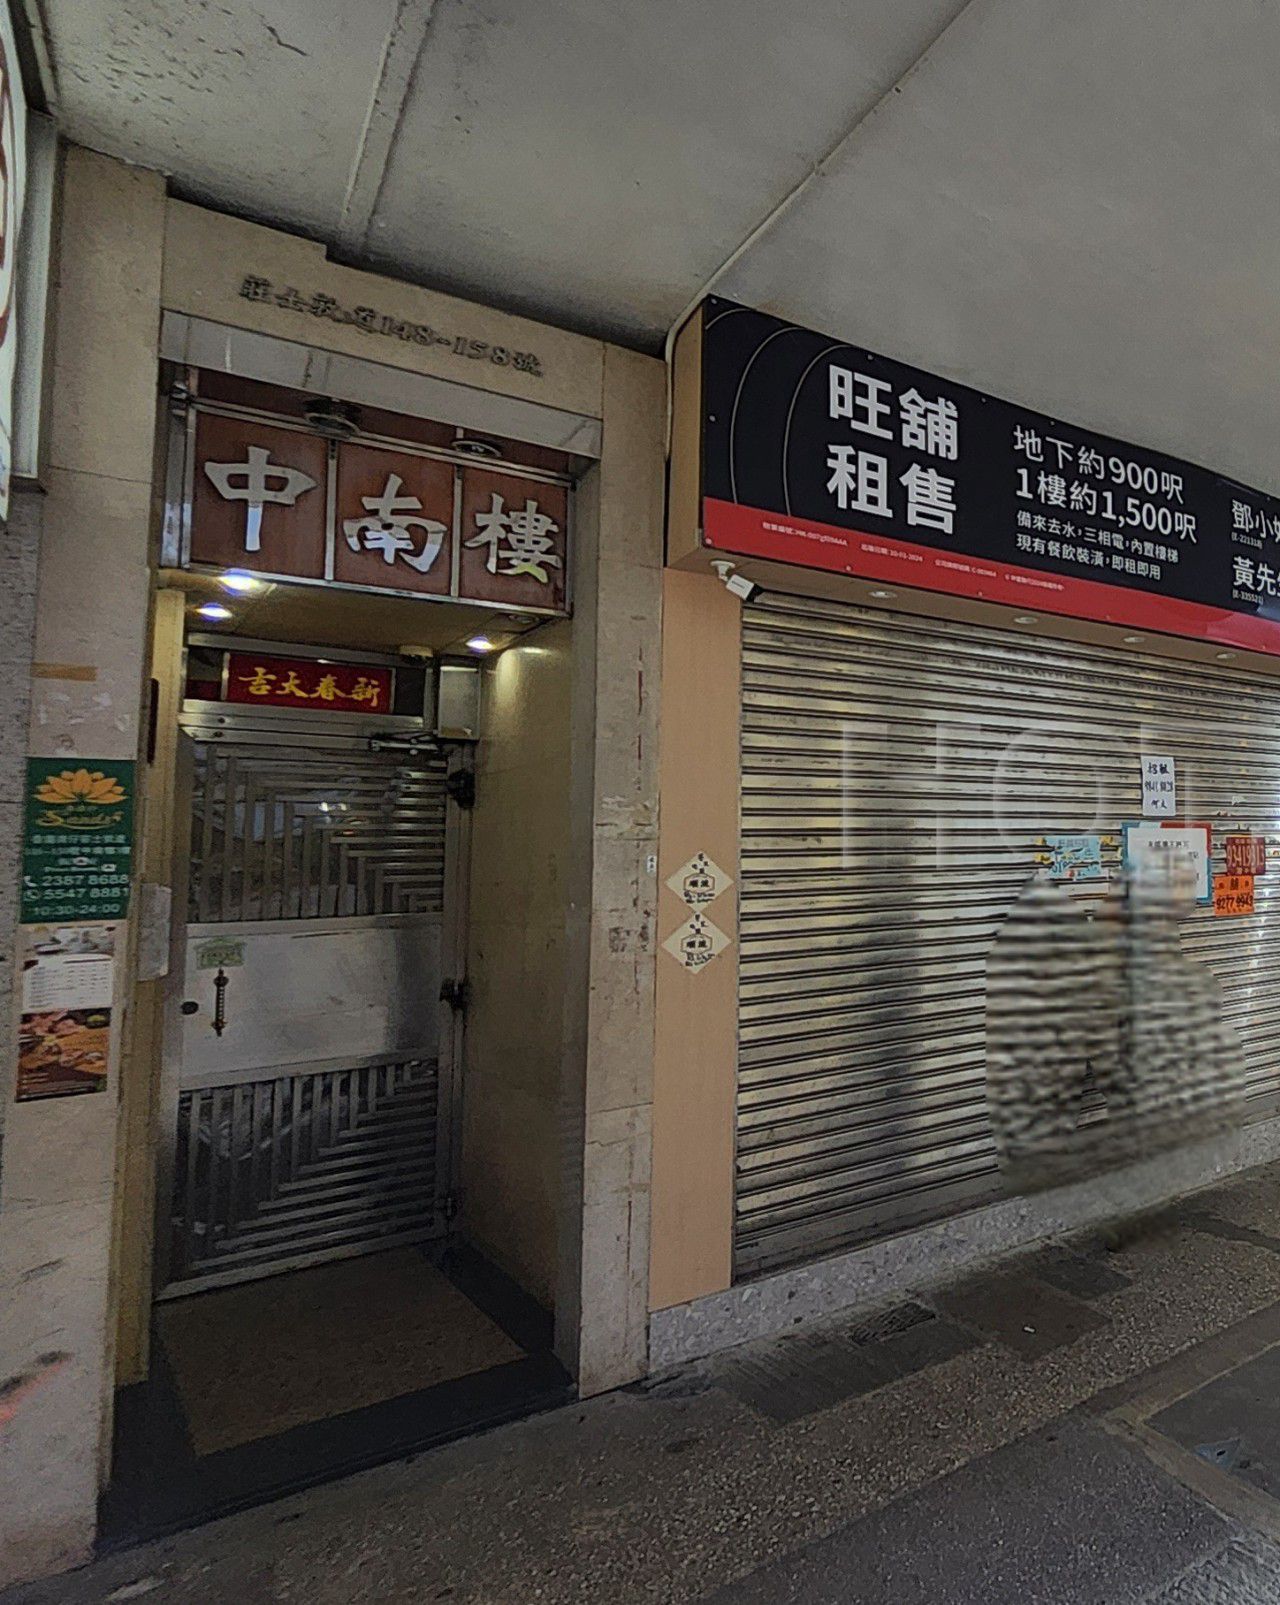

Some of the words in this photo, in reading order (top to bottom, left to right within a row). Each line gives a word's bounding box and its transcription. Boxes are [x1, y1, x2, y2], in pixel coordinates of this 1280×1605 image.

[828, 364, 959, 461] 旺舖
[826, 444, 958, 535] 租售
[1013, 425, 1184, 504] 地下約900呎
[1016, 468, 1197, 543] 1樓約1,500呎
[203, 444, 564, 583] 中南樓
